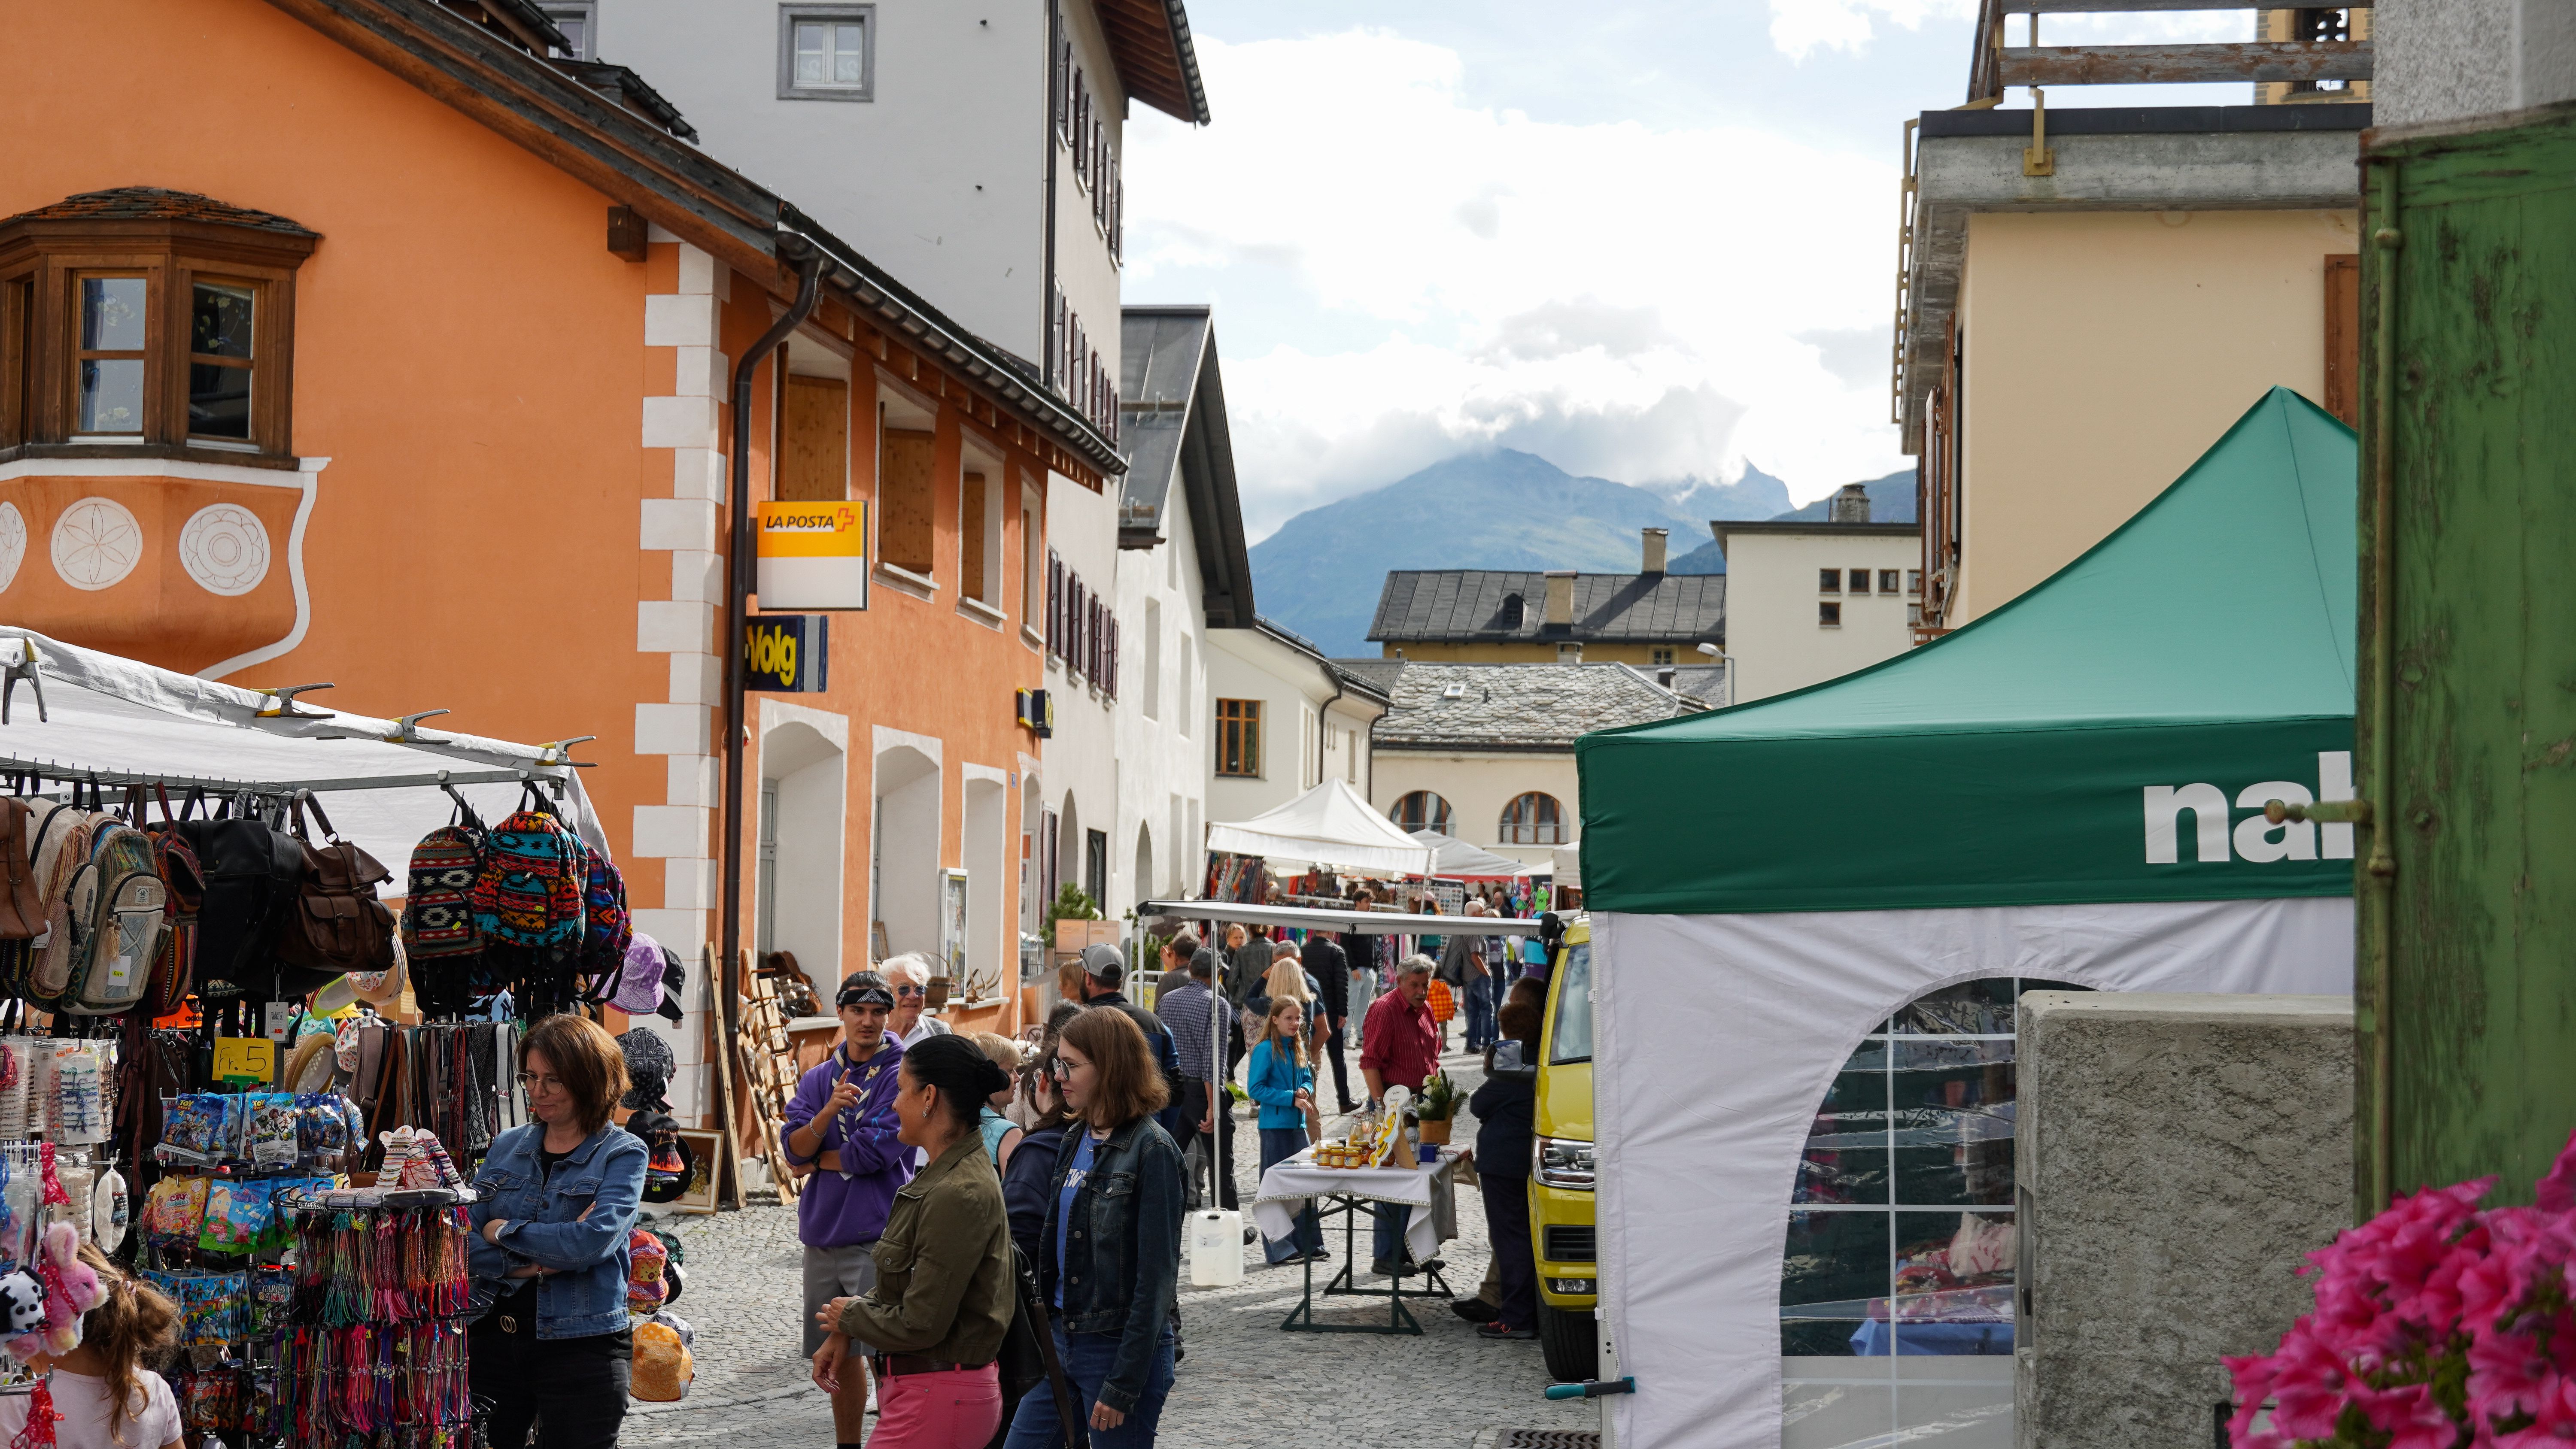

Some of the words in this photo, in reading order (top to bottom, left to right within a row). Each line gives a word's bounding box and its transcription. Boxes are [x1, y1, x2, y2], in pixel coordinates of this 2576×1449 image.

[766, 515, 783, 528] LA
[786, 515, 834, 528] POSTA
[747, 624, 796, 686] Volg
[246, 1046, 266, 1072] 5
[169, 1192, 188, 1201] CRY
